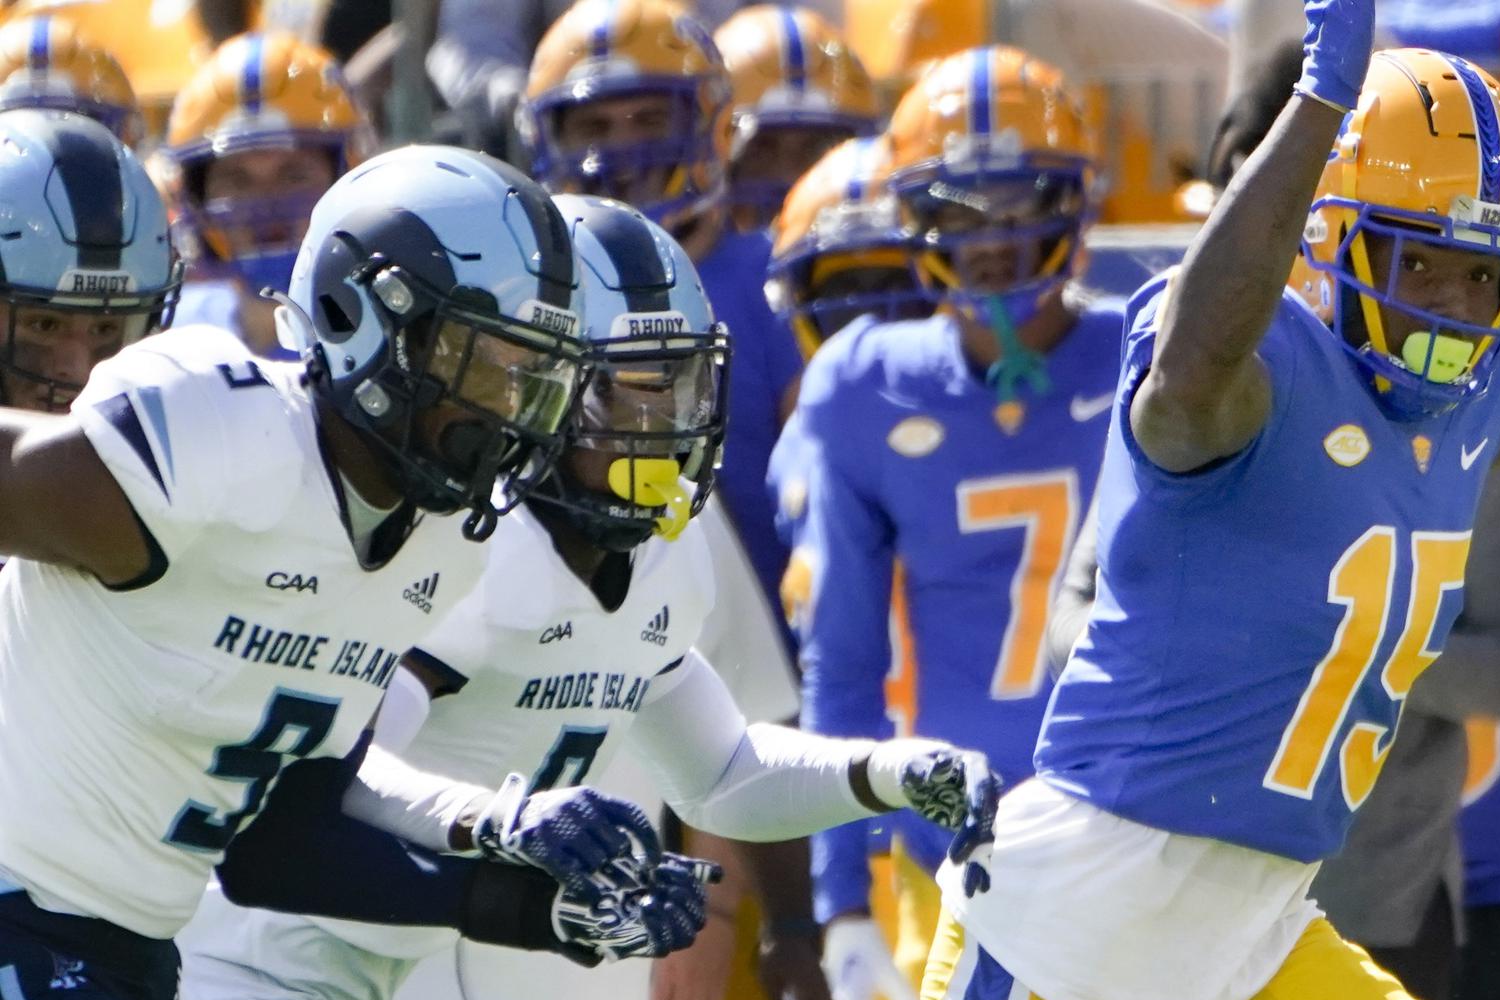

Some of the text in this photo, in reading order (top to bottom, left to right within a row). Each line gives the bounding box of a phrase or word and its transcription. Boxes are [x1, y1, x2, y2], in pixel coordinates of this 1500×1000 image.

[73, 274, 129, 291] RHODY
[531, 306, 577, 334] RHODY
[628, 317, 684, 336] RHODY
[266, 572, 319, 594] CAA
[955, 468, 1080, 700] 7
[214, 614, 330, 671] RHODE
[539, 621, 573, 644] CAA
[1262, 524, 1473, 813] 15
[515, 672, 599, 710] RHODE
